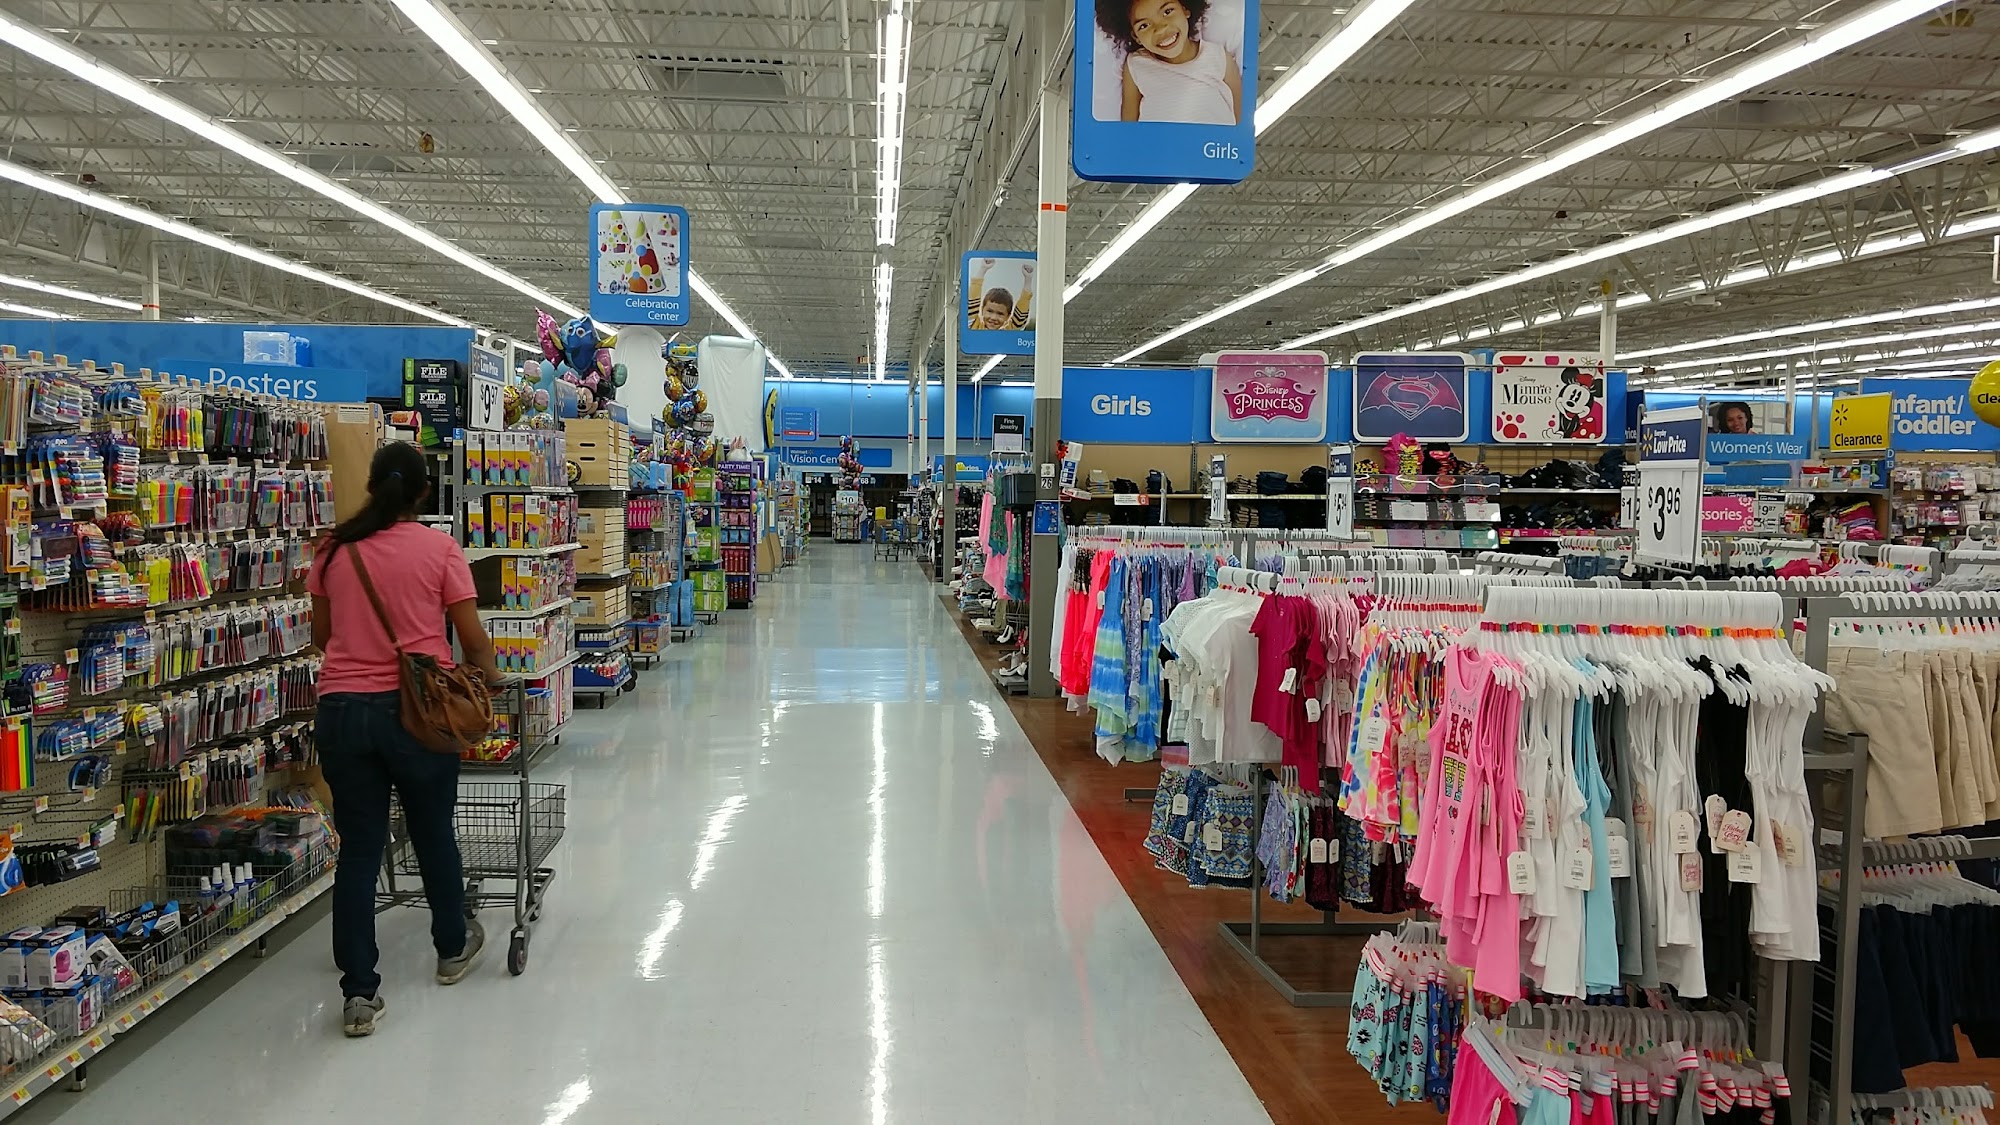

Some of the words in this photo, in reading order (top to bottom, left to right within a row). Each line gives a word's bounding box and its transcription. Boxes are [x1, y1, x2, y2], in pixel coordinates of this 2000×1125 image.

[1203, 142, 1239, 160] Girls
[625, 298, 679, 310] Celebration
[647, 311, 679, 321] Center
[1017, 337, 1035, 348] Boys
[420, 367, 447, 376] FILE
[209, 368, 317, 400] Posters
[419, 393, 446, 401] FILE
[1977, 393, 2000, 404] Clea
[1091, 394, 1152, 416] Girls
[1892, 394, 1965, 414] nfant/
[1000, 423, 1018, 431] Jewelry
[1653, 437, 1667, 454] Low
[1667, 435, 1687, 453] Price
[1834, 433, 1883, 447] Clearance
[1710, 440, 1773, 454] Women's
[1776, 441, 1803, 455] Wear
[790, 454, 818, 464] Vision
[819, 454, 837, 464] Cen
[1887, 449, 1895, 458] D
[1886, 460, 1895, 468] 13
[1041, 478, 1053, 489] 26
[1701, 508, 1742, 520] ssories
